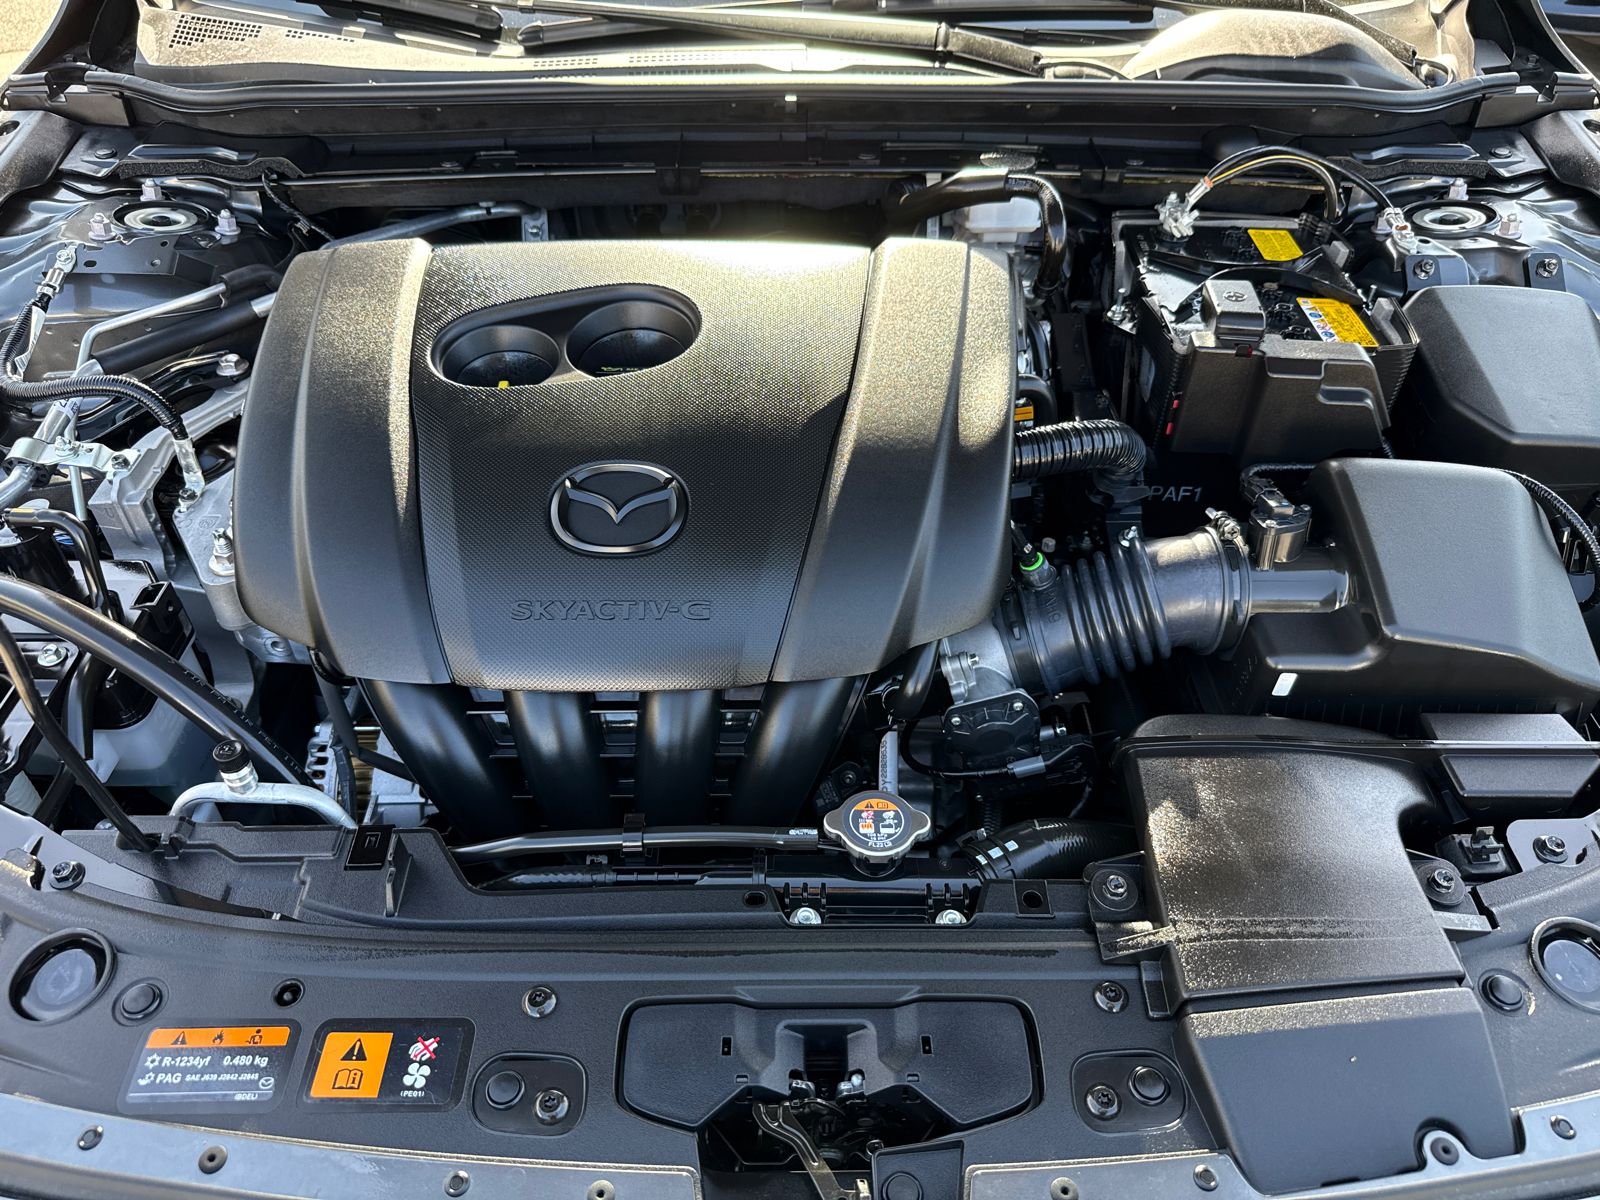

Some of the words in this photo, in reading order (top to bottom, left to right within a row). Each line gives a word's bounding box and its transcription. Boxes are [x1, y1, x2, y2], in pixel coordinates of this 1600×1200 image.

[1147, 485, 1202, 502] PAF1
[510, 600, 711, 621] SKYACTIV-G
[161, 1055, 211, 1068] R-1234yf
[223, 1055, 252, 1066] 0.480
[254, 1055, 269, 1067] kg
[156, 1072, 182, 1084] PAG
